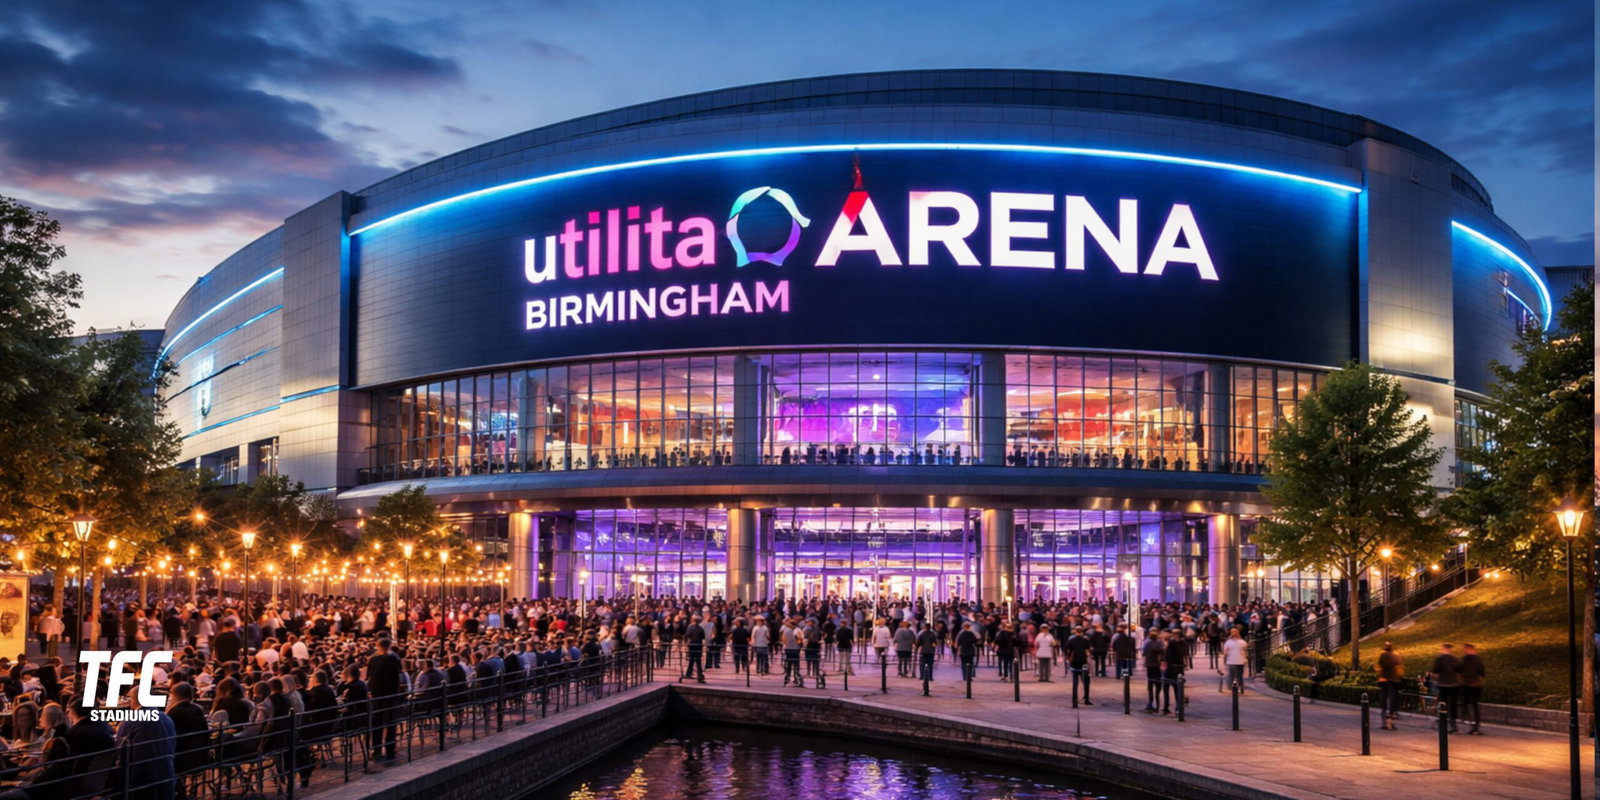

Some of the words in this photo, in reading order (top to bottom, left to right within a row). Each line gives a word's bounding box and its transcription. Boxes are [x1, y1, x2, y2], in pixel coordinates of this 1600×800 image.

[524, 206, 716, 284] utilita
[814, 190, 1220, 281] ARENA
[525, 280, 790, 331] BIRMINGHAM
